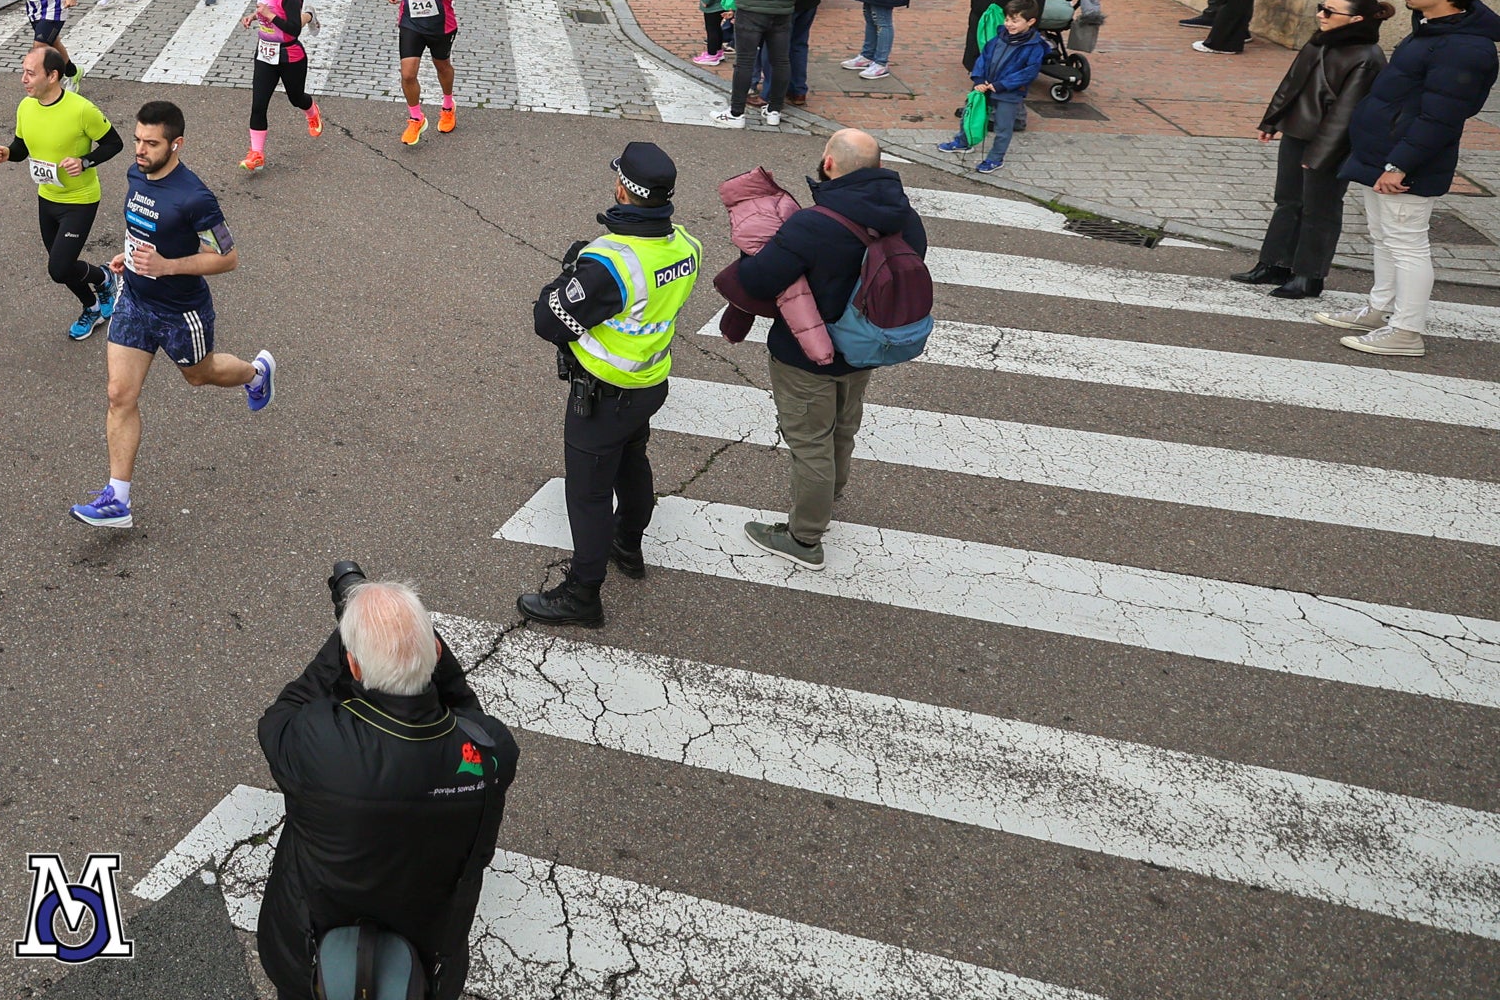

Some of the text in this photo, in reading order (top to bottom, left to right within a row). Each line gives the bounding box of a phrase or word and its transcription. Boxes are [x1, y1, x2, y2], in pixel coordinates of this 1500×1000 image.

[412, 1, 433, 10] 214
[260, 45, 276, 57] 215
[33, 165, 54, 179] 290
[132, 191, 156, 207] Juntos
[127, 198, 160, 220] logramos
[656, 257, 696, 287] POLICÍ
